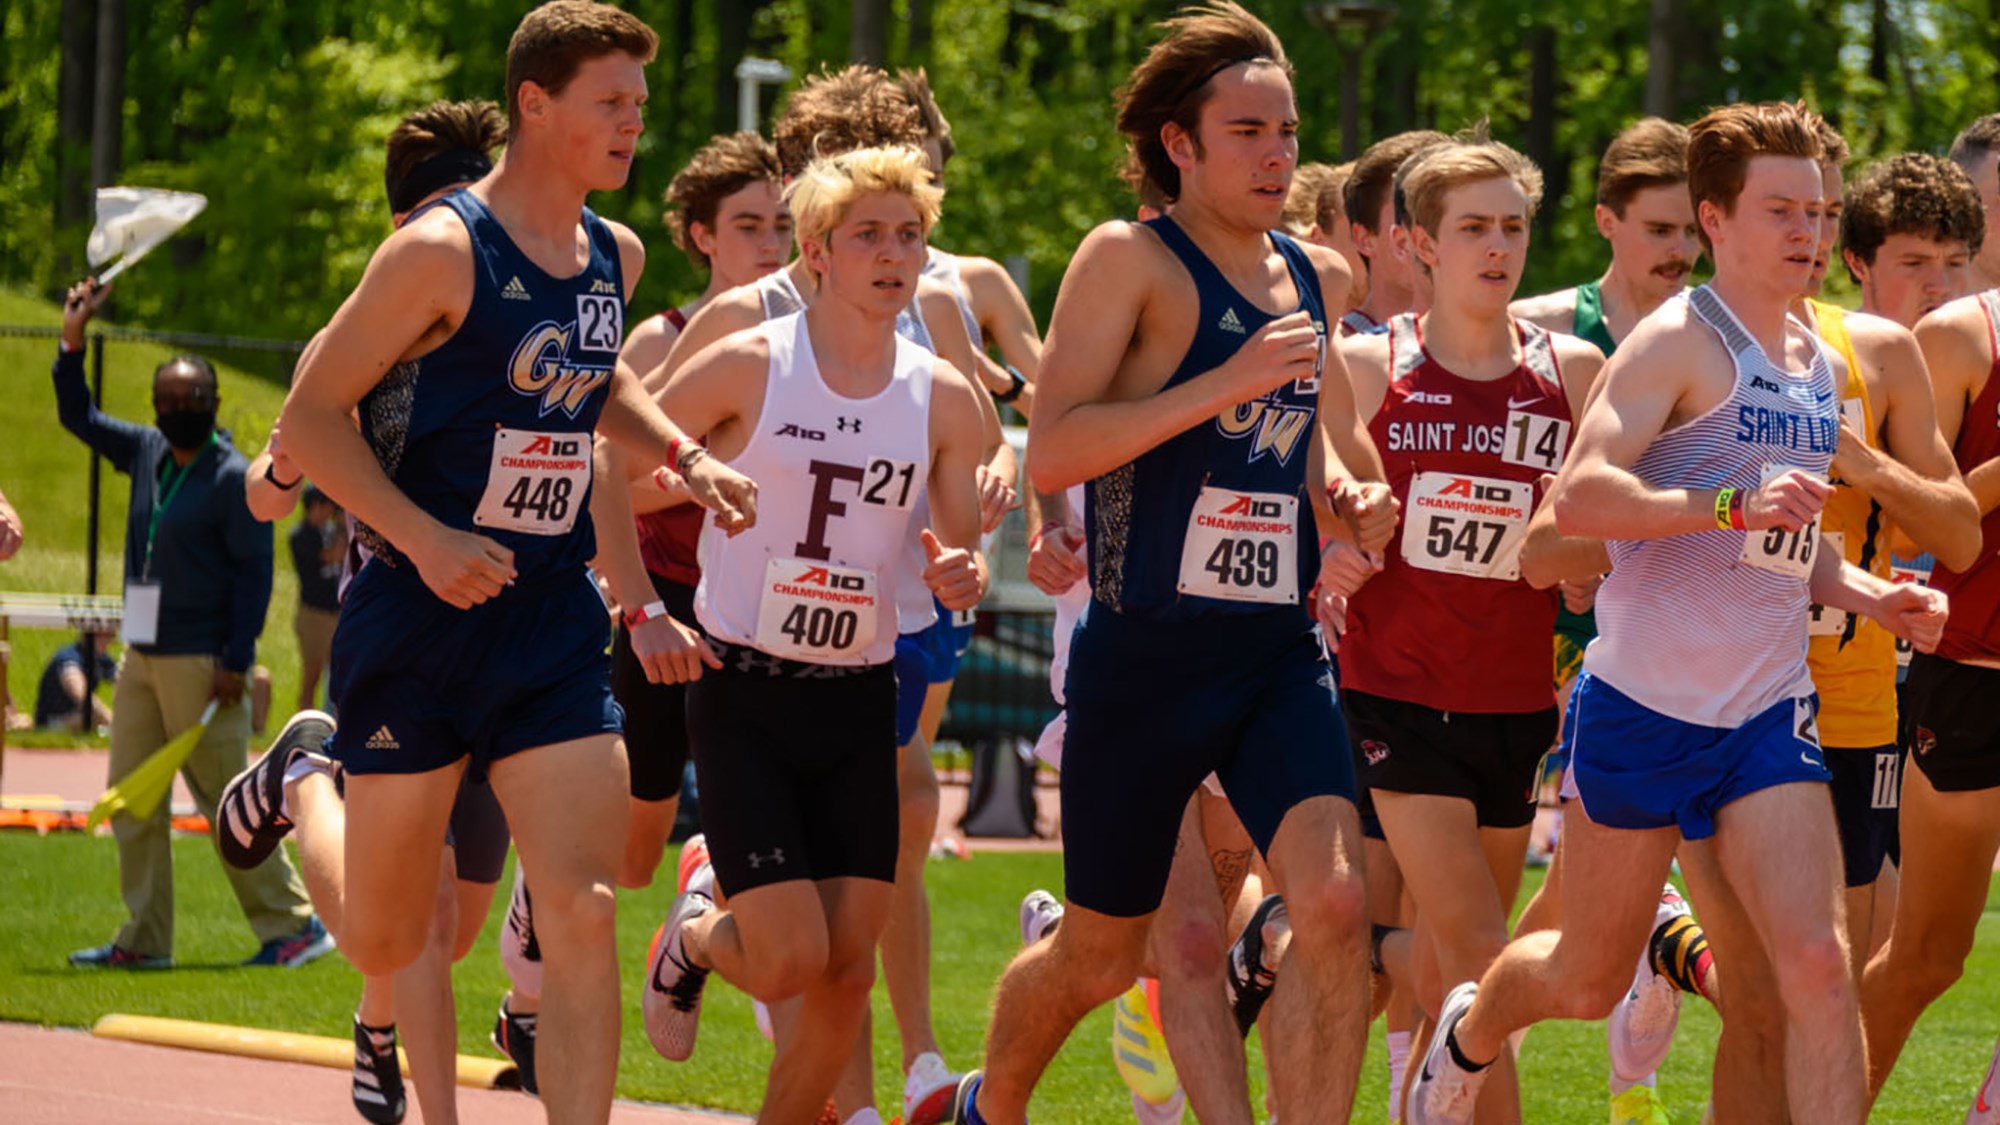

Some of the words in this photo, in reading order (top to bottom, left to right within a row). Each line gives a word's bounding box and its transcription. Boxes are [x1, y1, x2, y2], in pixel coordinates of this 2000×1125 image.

[582, 298, 618, 349] 23
[1750, 375, 1780, 393] A10
[1402, 391, 1453, 405] A10
[774, 423, 825, 441] A10
[1388, 422, 1456, 451] SAINT
[1512, 415, 1560, 467] 14
[1736, 405, 1800, 450] SAINT
[520, 436, 578, 456] A10
[501, 456, 586, 470] CHAMPIONSHIPS
[864, 459, 915, 507] 21
[1437, 477, 1512, 503] A10
[503, 477, 572, 521] 448
[794, 459, 865, 561] F
[1218, 496, 1281, 518] A10
[1416, 496, 1524, 519] CHAMPIONSHIPS
[1197, 515, 1293, 535] CHAMPIONSHIPS
[1426, 515, 1507, 565] 547
[1205, 538, 1279, 589] 439
[794, 566, 864, 591] A10
[773, 582, 874, 606] CHAMPIONSHIPS
[781, 604, 858, 650] 400
[1878, 756, 1896, 806] 11
